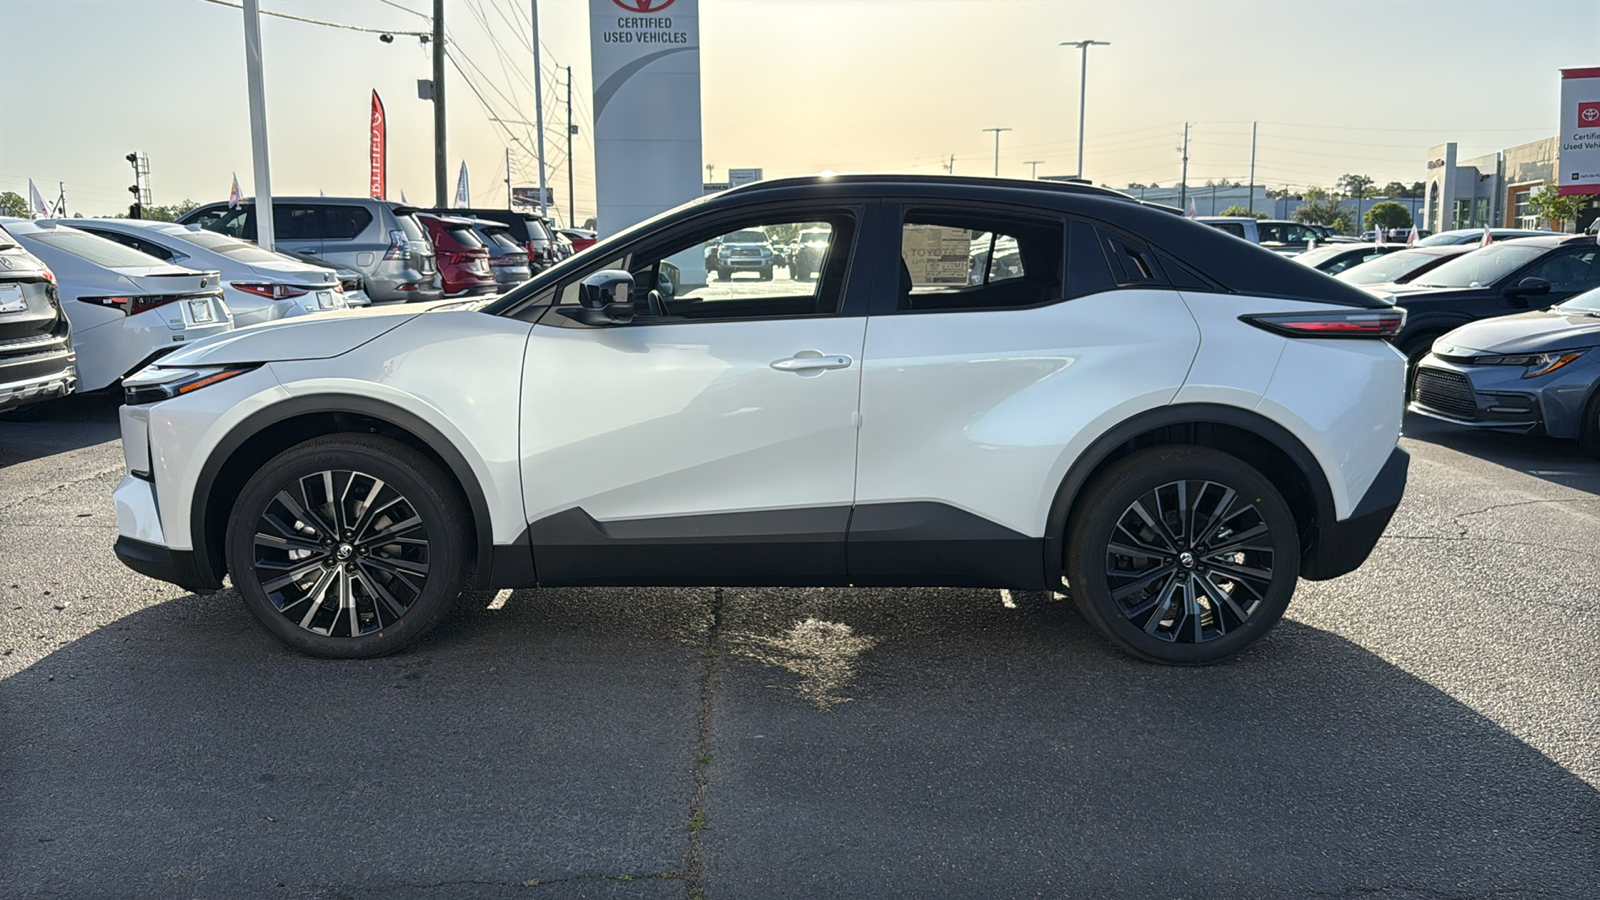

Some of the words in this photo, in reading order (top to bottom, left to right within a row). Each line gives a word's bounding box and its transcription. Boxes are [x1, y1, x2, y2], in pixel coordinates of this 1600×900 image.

[618, 17, 672, 29] CERTIFIED
[603, 31, 633, 43] USED
[635, 32, 687, 44] VEHICLES
[1563, 142, 1583, 150] Used
